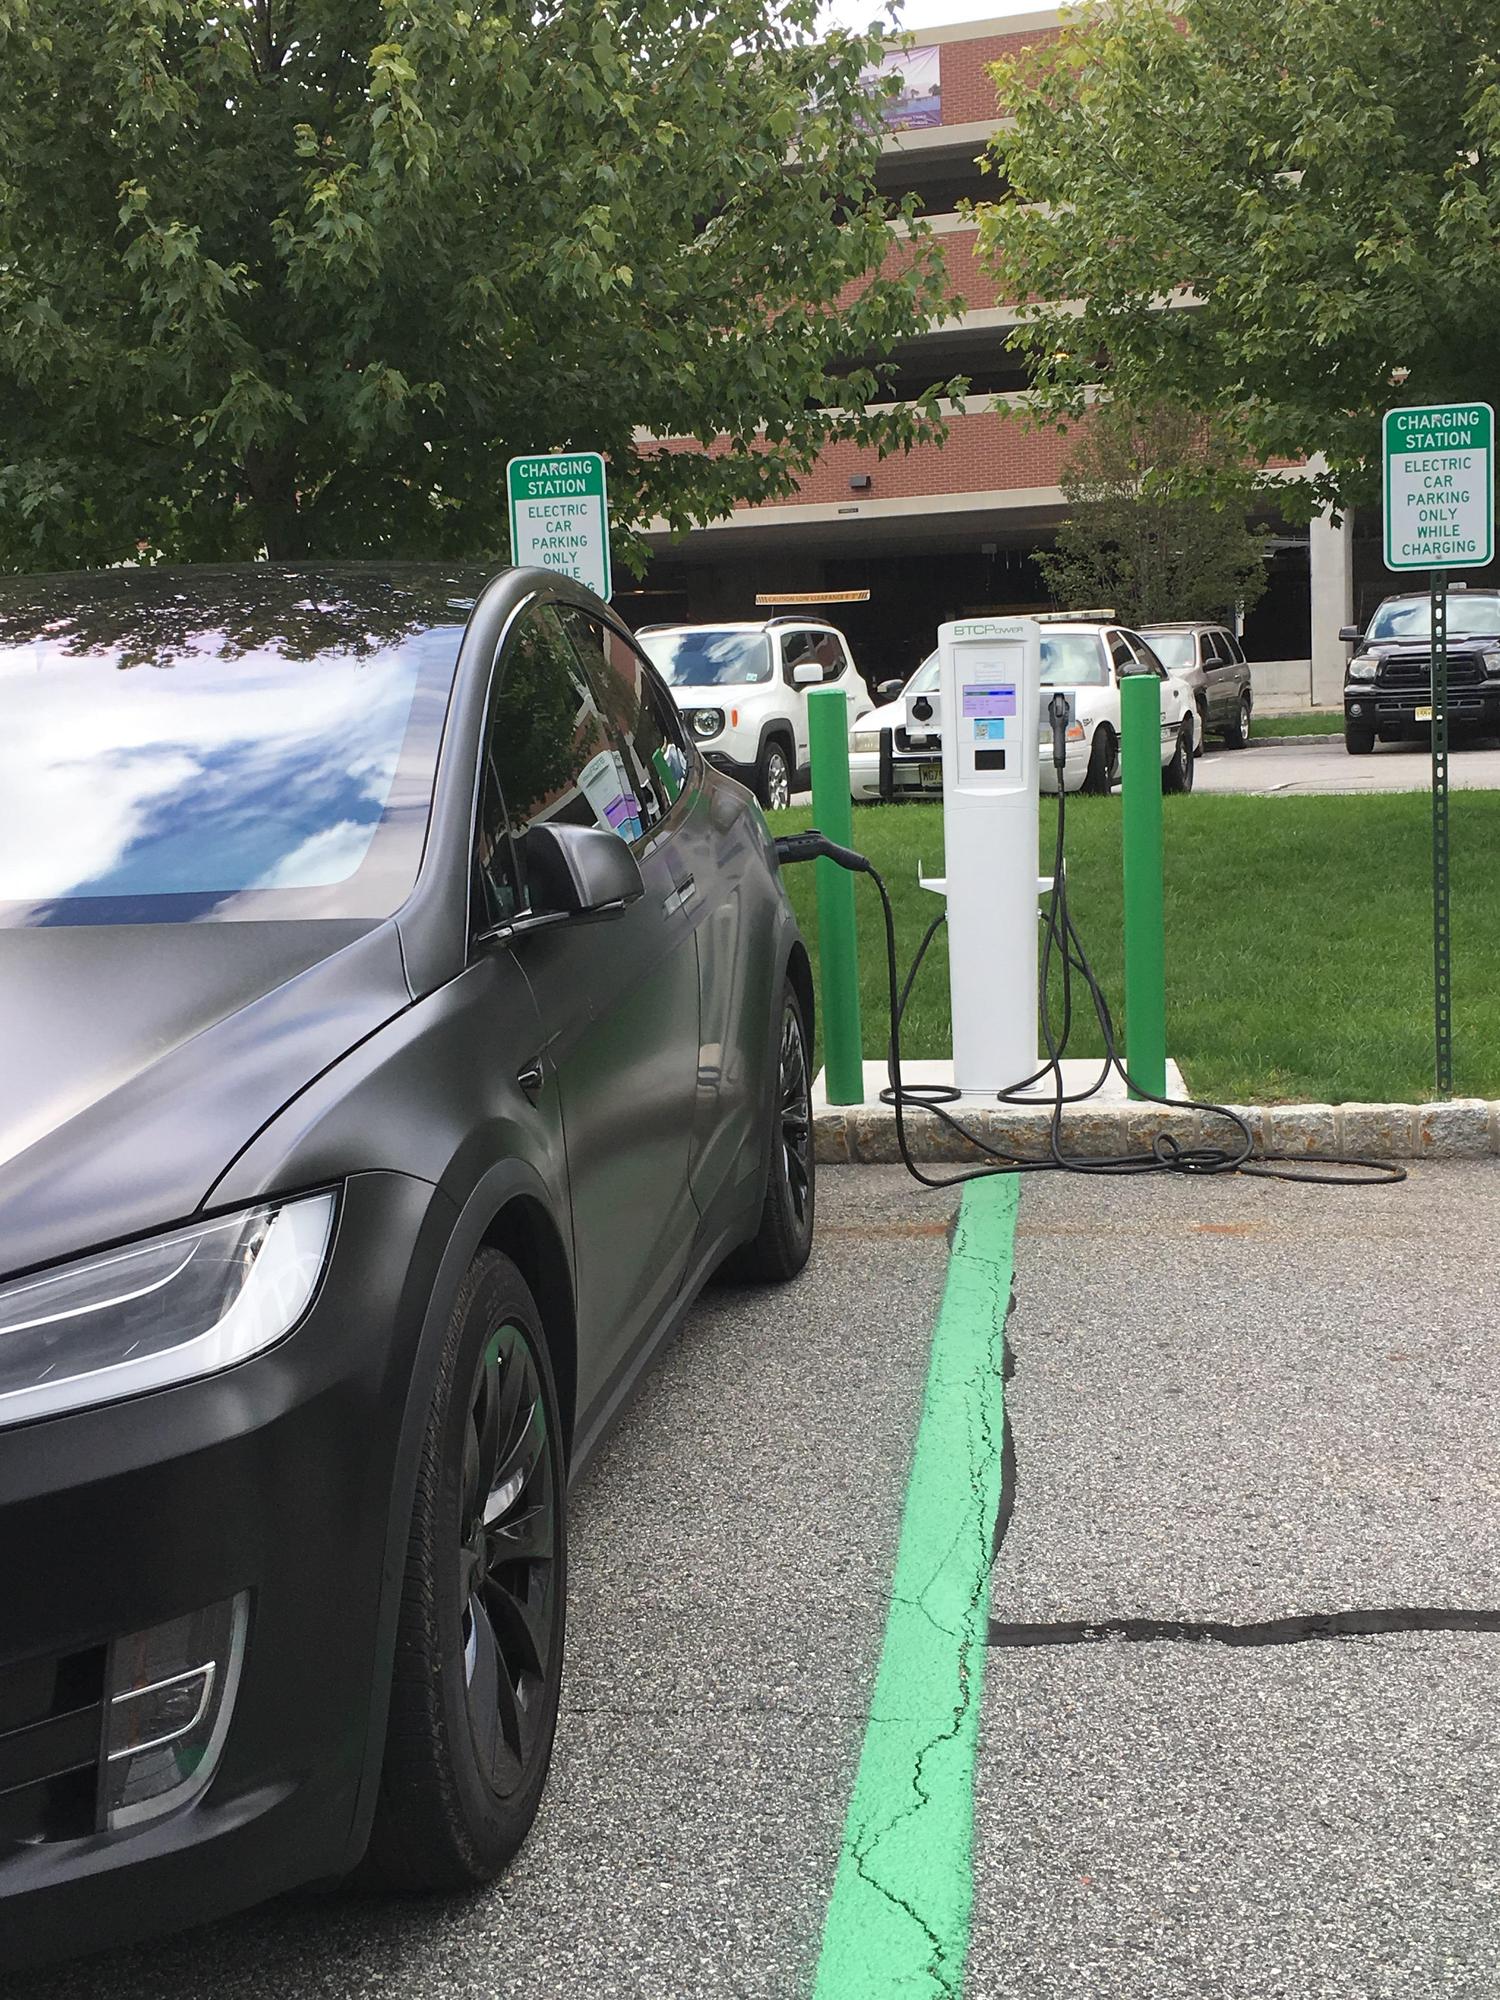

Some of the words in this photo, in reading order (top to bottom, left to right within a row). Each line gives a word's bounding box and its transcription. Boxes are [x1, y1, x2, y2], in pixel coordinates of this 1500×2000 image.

[1397, 411, 1480, 431] CHARGING
[1406, 431, 1472, 449] STATION
[519, 460, 593, 478] CHARGING
[1405, 457, 1472, 473] ELECTRIC
[528, 478, 586, 495] STATION
[1424, 475, 1453, 489] CAR
[1407, 491, 1470, 506] PARKING
[528, 503, 588, 519] ELECTRIC
[1419, 508, 1458, 522] ONLY
[546, 520, 572, 533] CAR
[1417, 524, 1461, 539] WHILE
[532, 535, 588, 550] PARKING
[1402, 540, 1476, 556] CHARGING
[543, 551, 578, 565] ONLY
[552, 567, 581, 579] ILE
